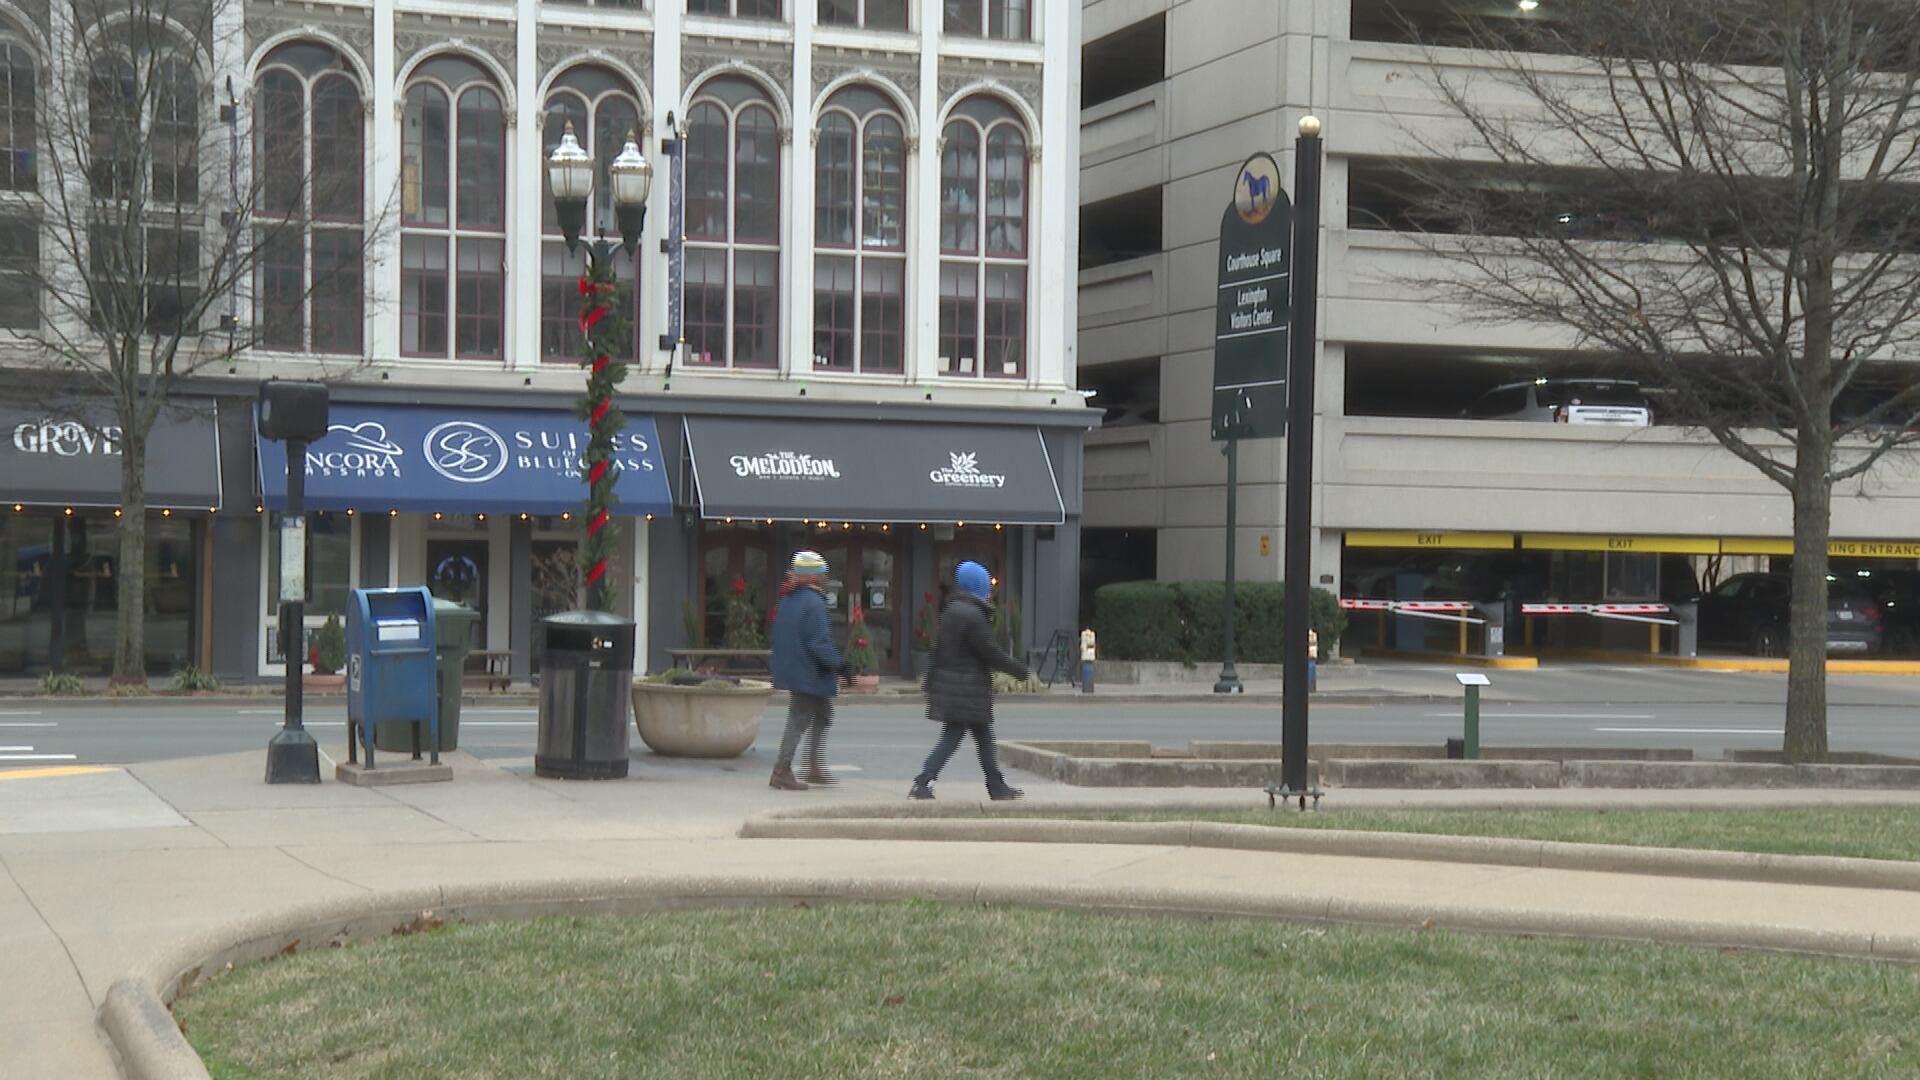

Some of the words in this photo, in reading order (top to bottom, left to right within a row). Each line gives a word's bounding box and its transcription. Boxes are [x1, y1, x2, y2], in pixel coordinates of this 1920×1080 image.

[1226, 253, 1260, 272] Courthouse
[1260, 248, 1282, 269] Square
[1236, 287, 1268, 308] Lexington
[1230, 312, 1252, 329] Visitors
[1252, 308, 1274, 327] Center
[13, 422, 124, 456] GROVE
[514, 431, 649, 452] SUIES
[305, 452, 399, 470] NCORA
[518, 454, 654, 472] BLUEGASS
[729, 454, 841, 478] MELODEON
[284, 467, 402, 478] ASSAGE
[929, 470, 1005, 488] Greenery
[1417, 535, 1443, 545] EXIT
[1608, 539, 1634, 549] EXIT
